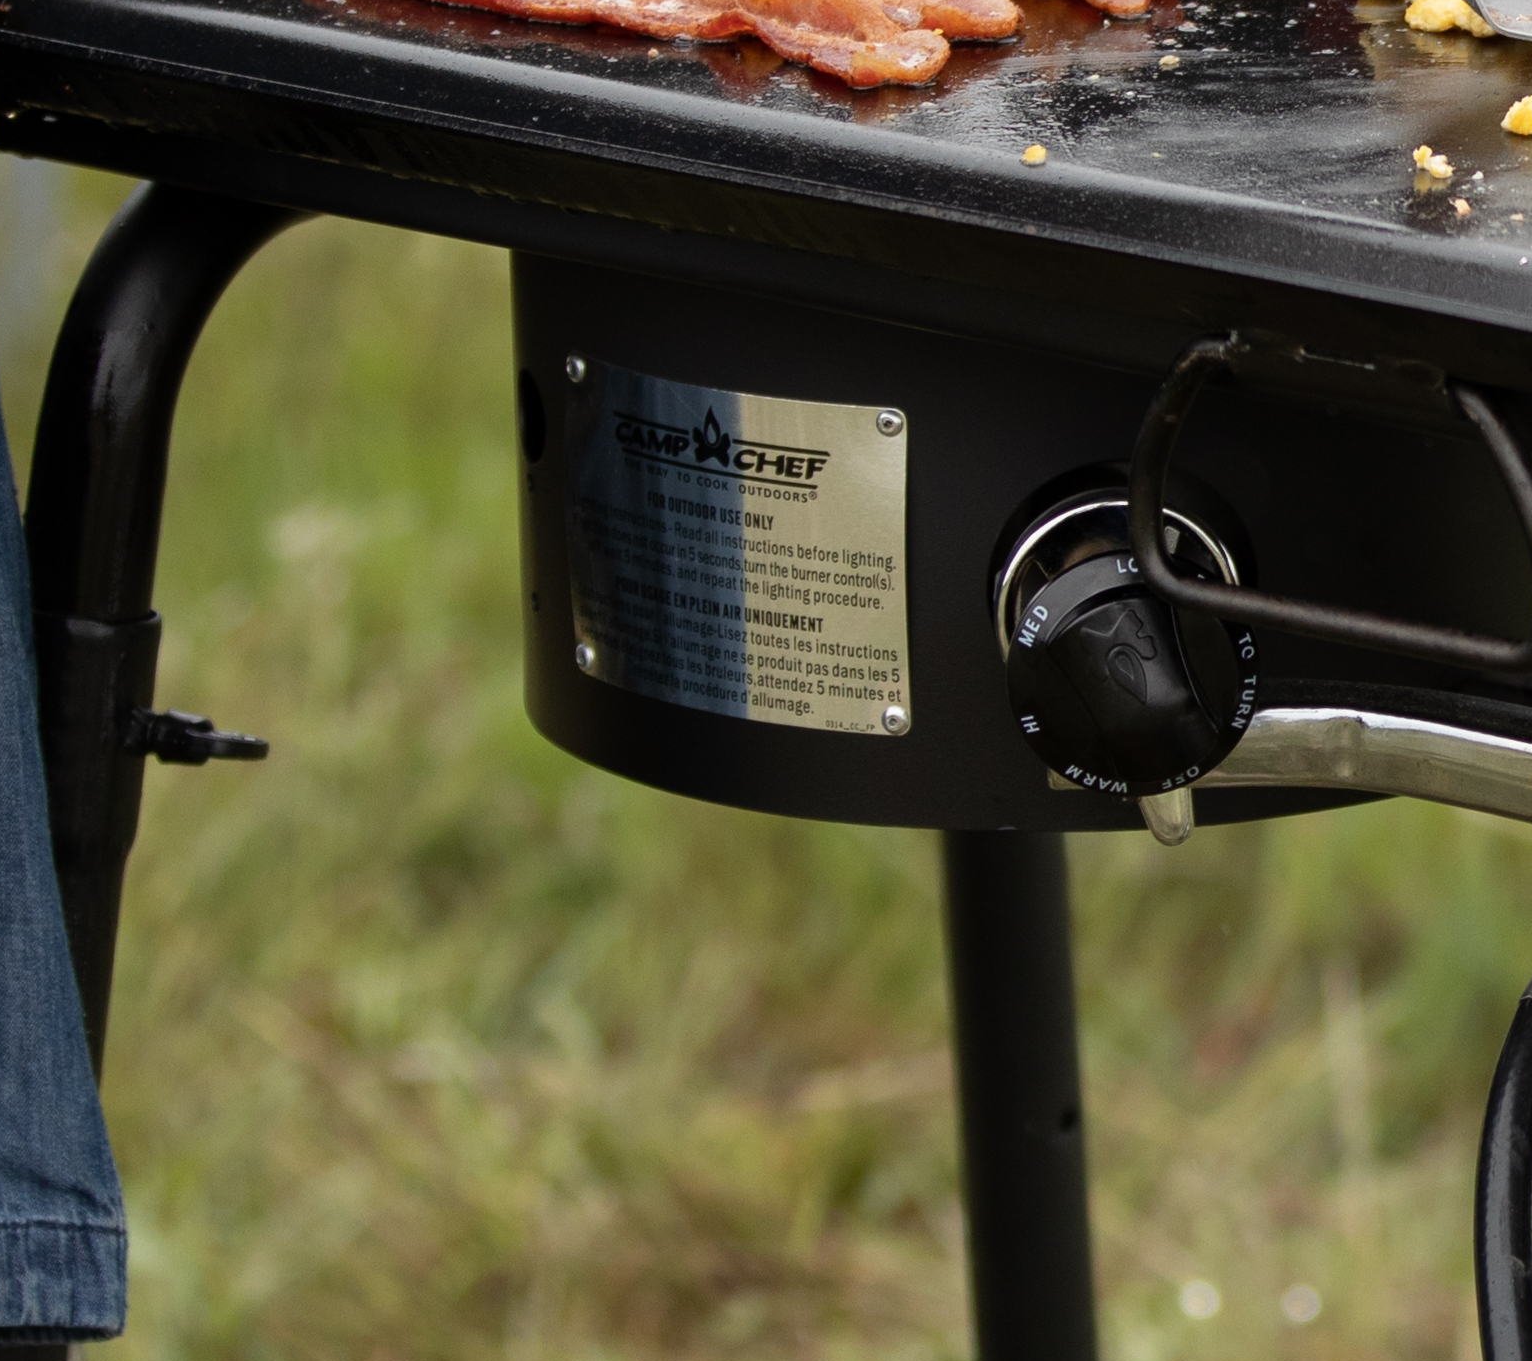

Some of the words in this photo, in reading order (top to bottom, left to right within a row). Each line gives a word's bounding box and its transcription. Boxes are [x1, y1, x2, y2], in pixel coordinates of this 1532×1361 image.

[615, 422, 689, 457] CAMP
[733, 449, 827, 480] CHEF
[624, 458, 641, 472] THE
[646, 465, 669, 478] WAY
[677, 472, 691, 483] TO
[696, 476, 728, 491] COOK
[648, 491, 666, 506] FOR
[668, 497, 716, 521] OUTDOOR
[720, 507, 741, 526] USE
[744, 512, 774, 530] ONLY
[650, 540, 675, 556] occur
[677, 544, 687, 559] in
[689, 546, 696, 561] 5
[770, 561, 788, 578] the
[791, 564, 830, 583] burner
[834, 573, 894, 592] control(s).
[674, 522, 701, 541] Read
[704, 530, 718, 545] all
[721, 532, 794, 557] instructions
[797, 543, 839, 563] before
[842, 549, 896, 573] lighting.
[1116, 558, 1139, 574] LO
[678, 565, 697, 582] and
[699, 572, 737, 590] repeat
[740, 577, 759, 594] the
[762, 581, 810, 605] lighting
[813, 590, 884, 610] procedure.
[641, 581, 671, 606] USAGE
[674, 593, 687, 609] EN
[689, 596, 720, 617] PLEIN
[722, 604, 741, 622] AIR
[744, 607, 824, 633] UNIQUEMENT
[1018, 604, 1049, 648] MED
[750, 630, 790, 649] toutes
[793, 636, 812, 653] les
[815, 639, 898, 661] instructions
[1238, 632, 1255, 659] TO
[662, 652, 684, 671] tous
[686, 660, 703, 675] les
[816, 680, 825, 696] 5
[828, 682, 884, 701] minutes
[887, 689, 901, 703] et
[724, 648, 738, 663] ne
[740, 651, 754, 665] se
[757, 655, 802, 673] produit
[806, 664, 829, 677] pas
[832, 663, 865, 681] dans
[868, 666, 887, 682] les
[891, 668, 900, 683] 5
[682, 679, 738, 702] procédure
[1231, 674, 1257, 729] TURN
[1020, 714, 1040, 734] HI
[1065, 764, 1128, 793] WARM
[1162, 765, 1200, 789] OFF
